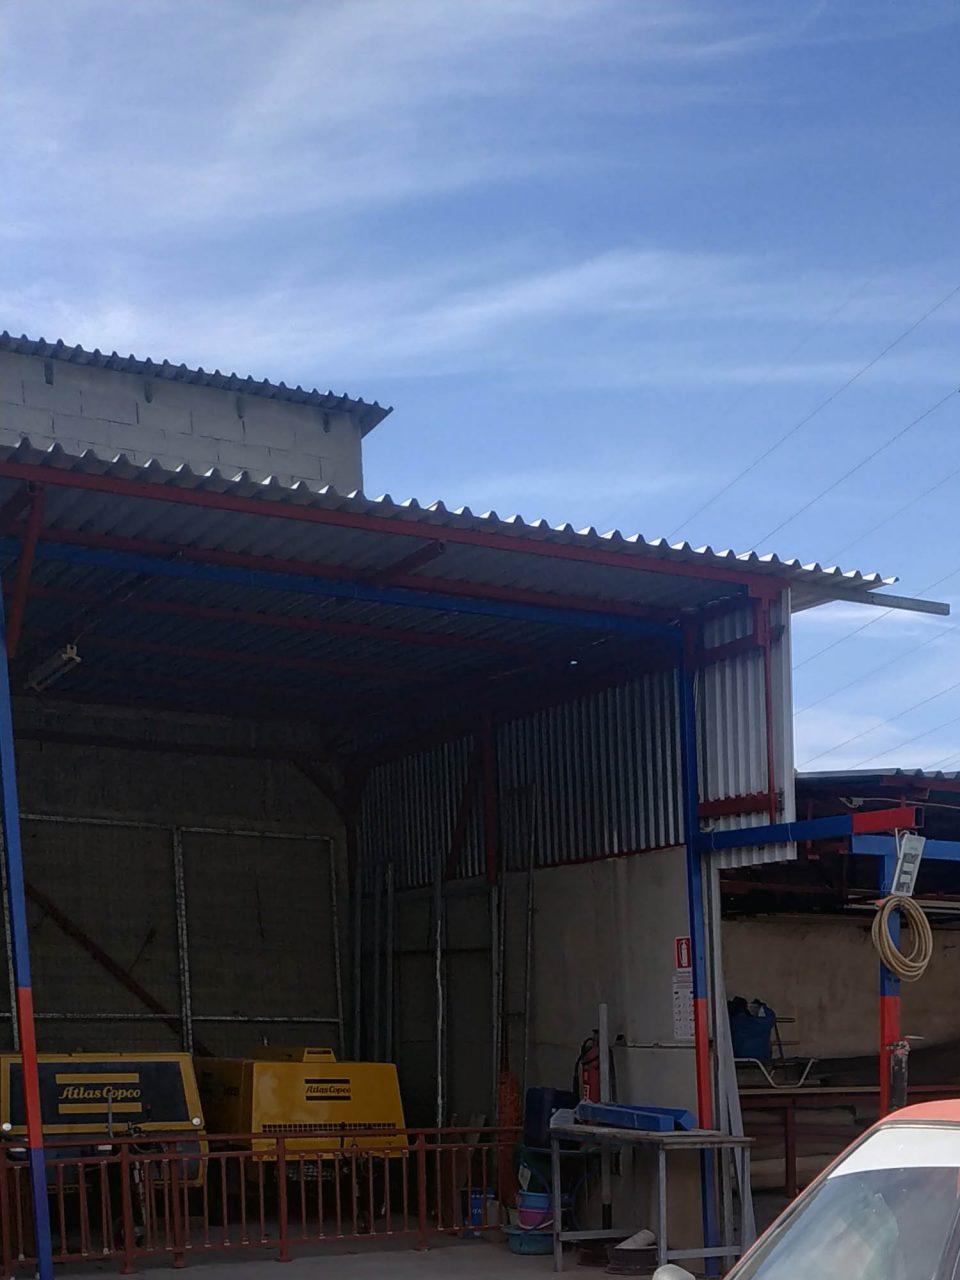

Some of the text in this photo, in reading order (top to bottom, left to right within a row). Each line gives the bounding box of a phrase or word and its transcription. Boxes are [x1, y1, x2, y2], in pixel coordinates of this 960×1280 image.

[58, 1086, 141, 1100] Atlas Copco
[305, 1086, 328, 1095] Atlas
